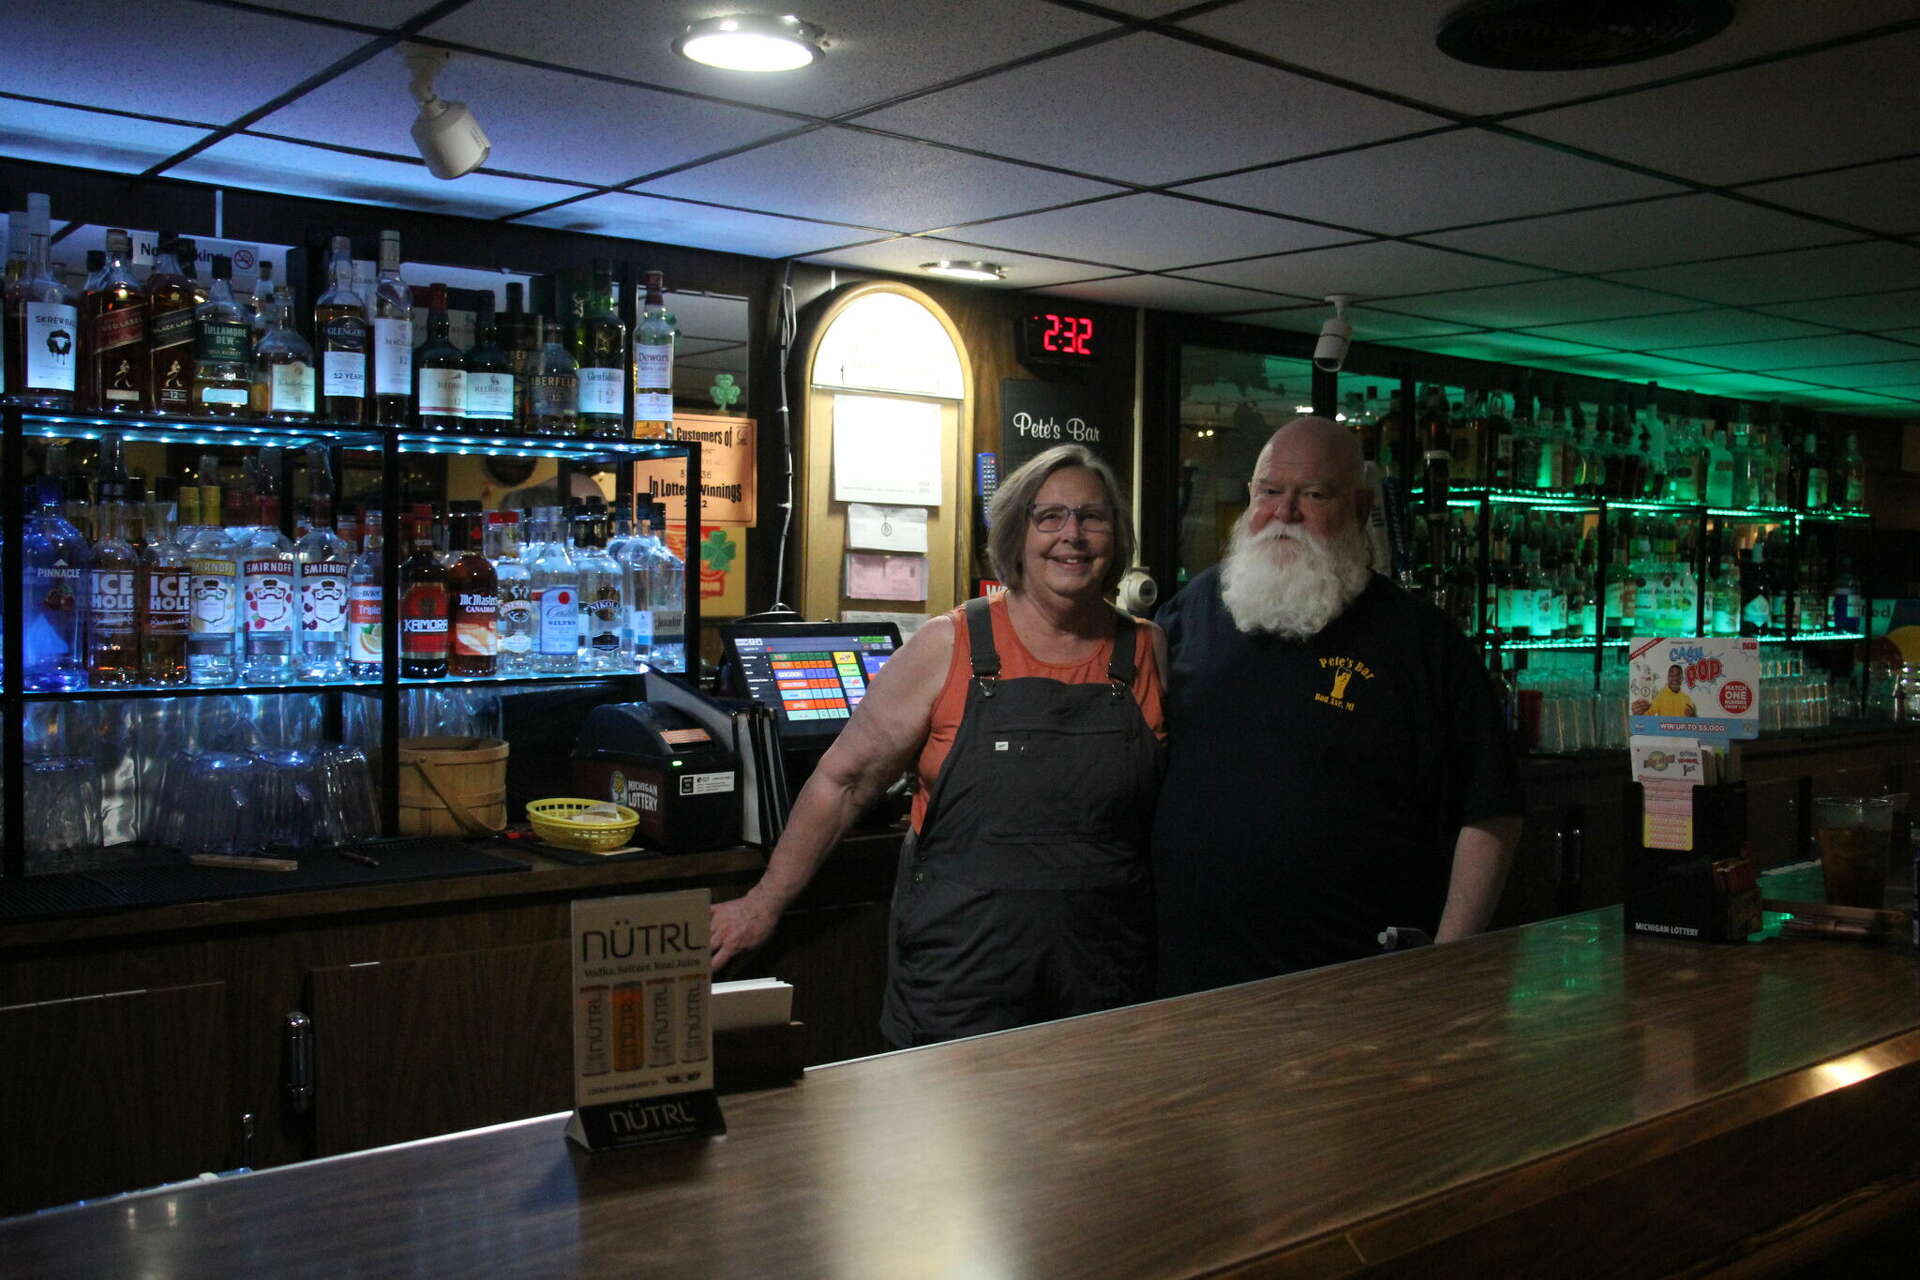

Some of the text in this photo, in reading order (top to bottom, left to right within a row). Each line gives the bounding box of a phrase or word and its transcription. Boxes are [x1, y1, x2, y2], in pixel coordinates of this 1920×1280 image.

[1043, 314, 1093, 355] 2:32
[1013, 412, 1101, 443] Pete's Bar
[676, 426, 733, 448] Customers of
[37, 567, 81, 579] PINNACLE
[245, 562, 292, 573] SMIRNOFF
[303, 563, 346, 574] SMIRNOFF
[91, 573, 134, 594] ICE
[150, 575, 190, 597] ICE
[91, 594, 134, 610] HOLE
[150, 596, 190, 612] HOLE
[403, 619, 447, 631] KAMORA
[1318, 656, 1376, 680] Pete's Bar
[1685, 658, 1722, 689] POP
[1725, 691, 1747, 699] ONE
[628, 781, 659, 799] MICHIGAN
[628, 792, 659, 814] LOTTERY
[1635, 922, 1699, 936] MICHIGAN LOTTERY
